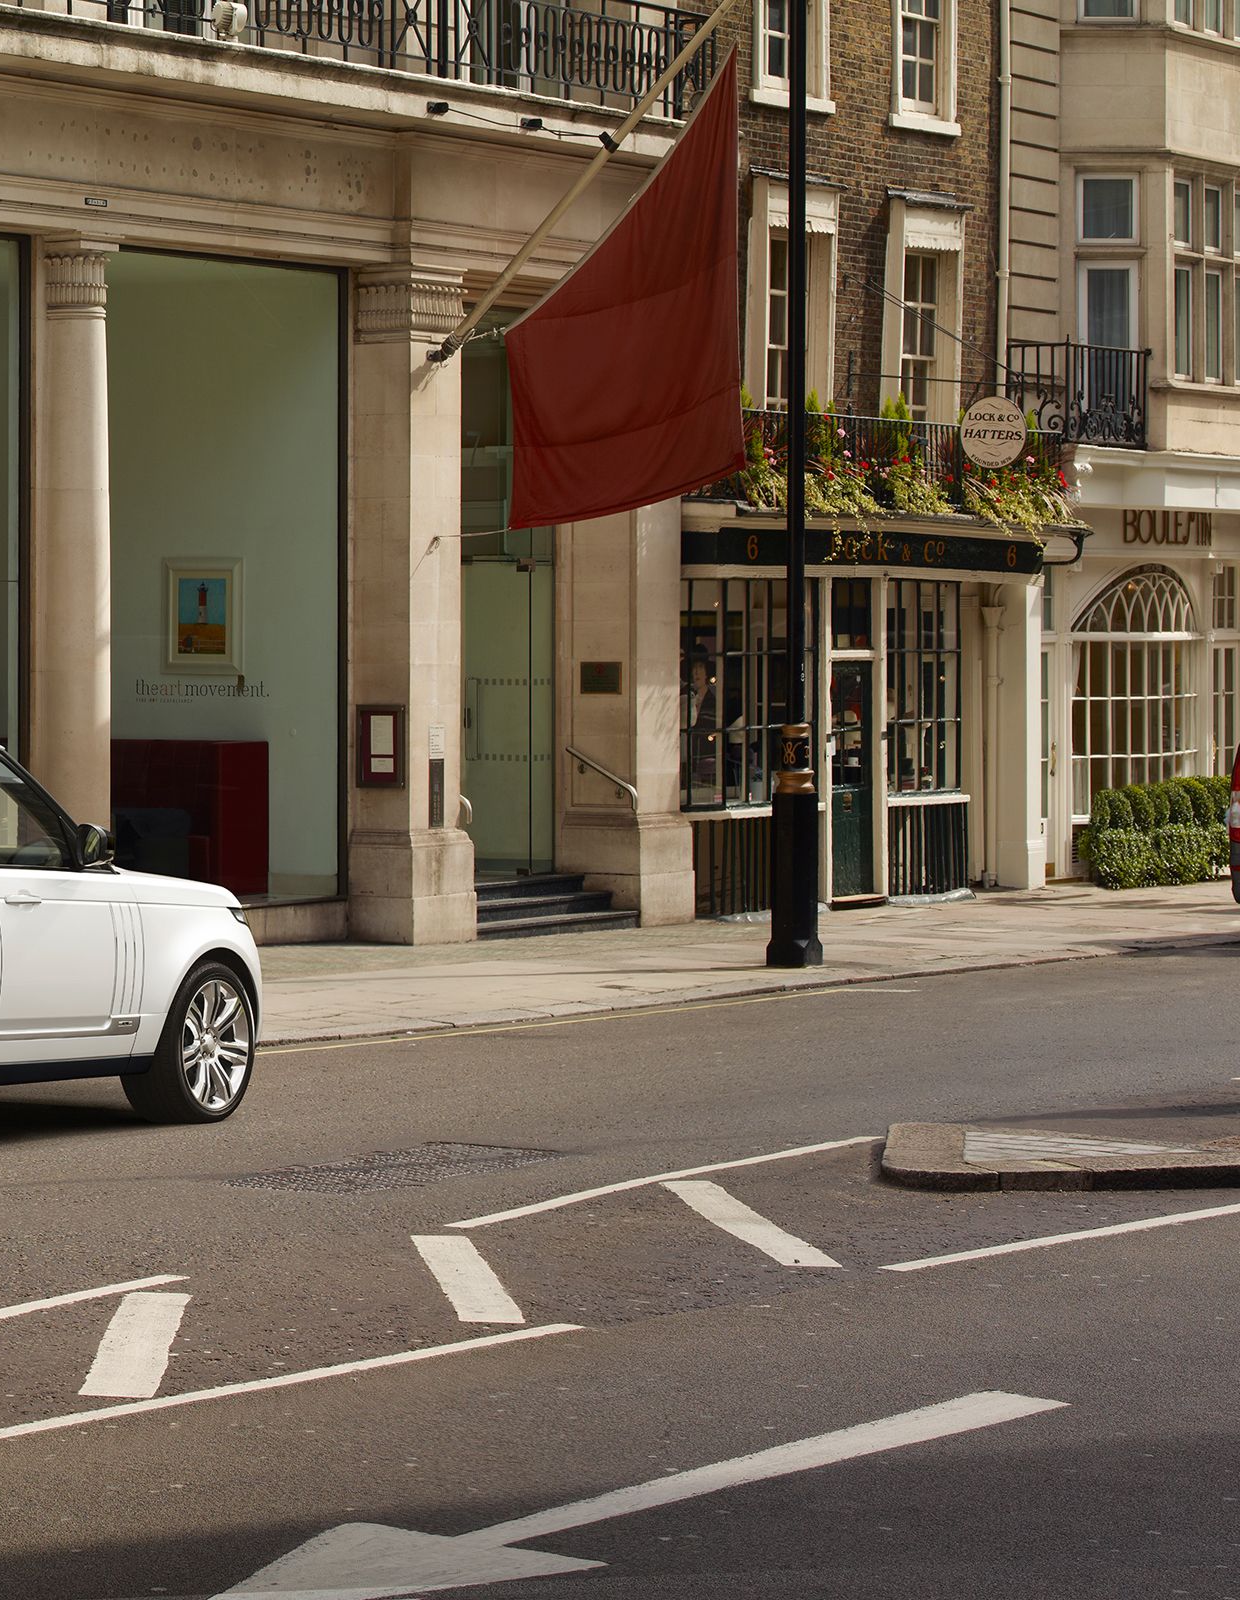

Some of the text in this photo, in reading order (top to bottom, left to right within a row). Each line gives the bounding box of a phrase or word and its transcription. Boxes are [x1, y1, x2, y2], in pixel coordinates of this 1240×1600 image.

[968, 412, 995, 422] LOCK
[997, 413, 1005, 422] &
[963, 428, 1024, 441] HATTERS.
[970, 454, 999, 467] FOUNDED
[746, 534, 759, 560] 6
[830, 534, 890, 561] LOCK
[901, 543, 912, 562] &
[1006, 544, 1017, 568] 6
